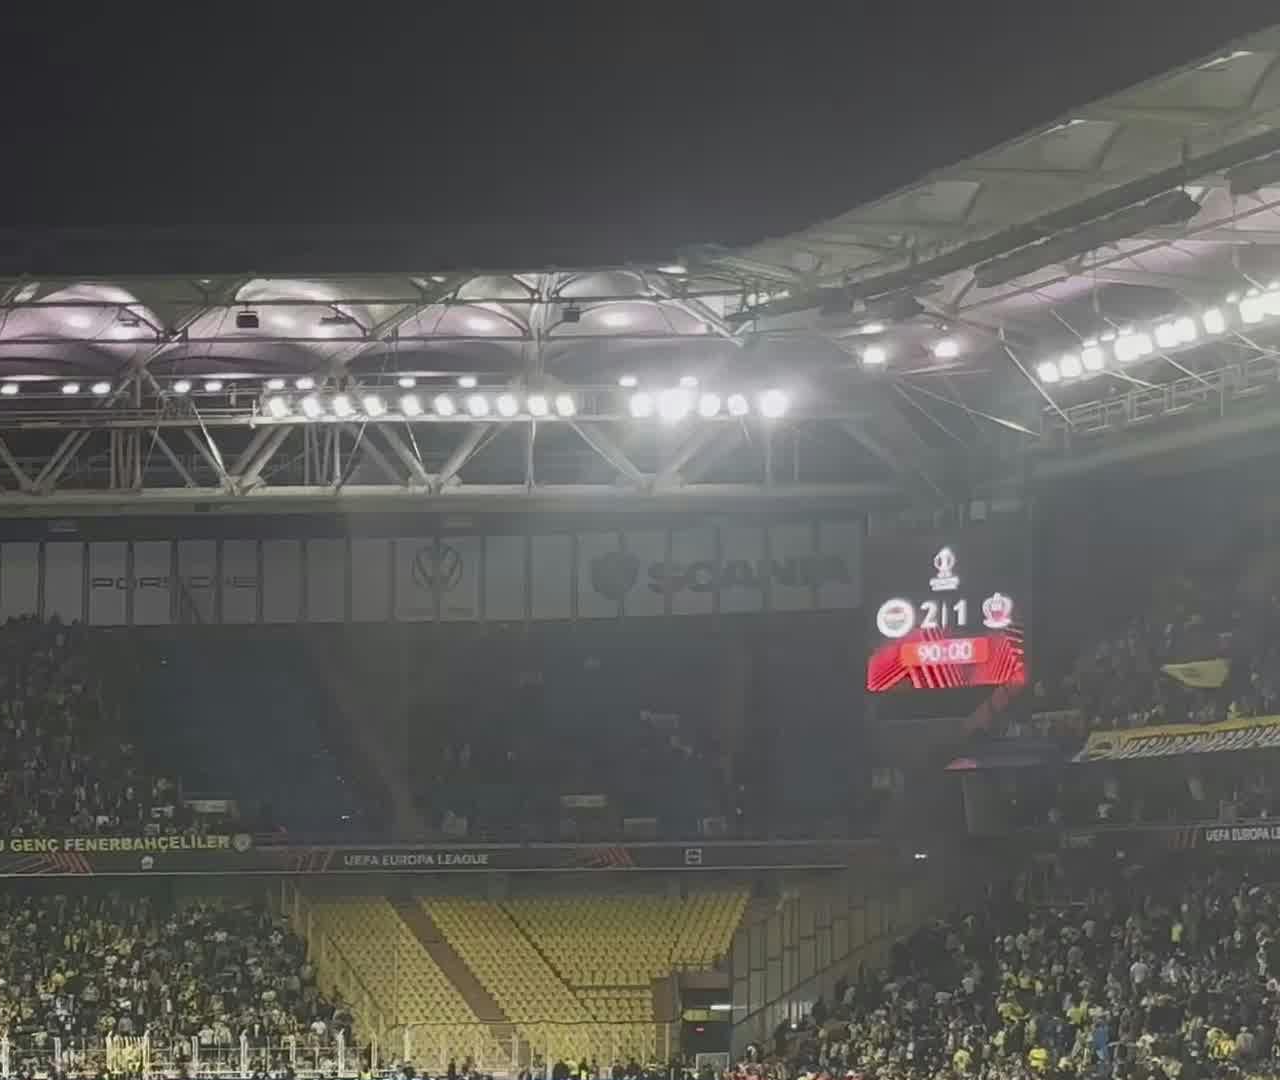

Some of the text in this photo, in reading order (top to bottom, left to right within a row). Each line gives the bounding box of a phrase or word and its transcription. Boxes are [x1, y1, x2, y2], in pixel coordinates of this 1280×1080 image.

[920, 601, 967, 628] 2 1
[344, 853, 489, 865] UEFA EUROPA LEAGUE
